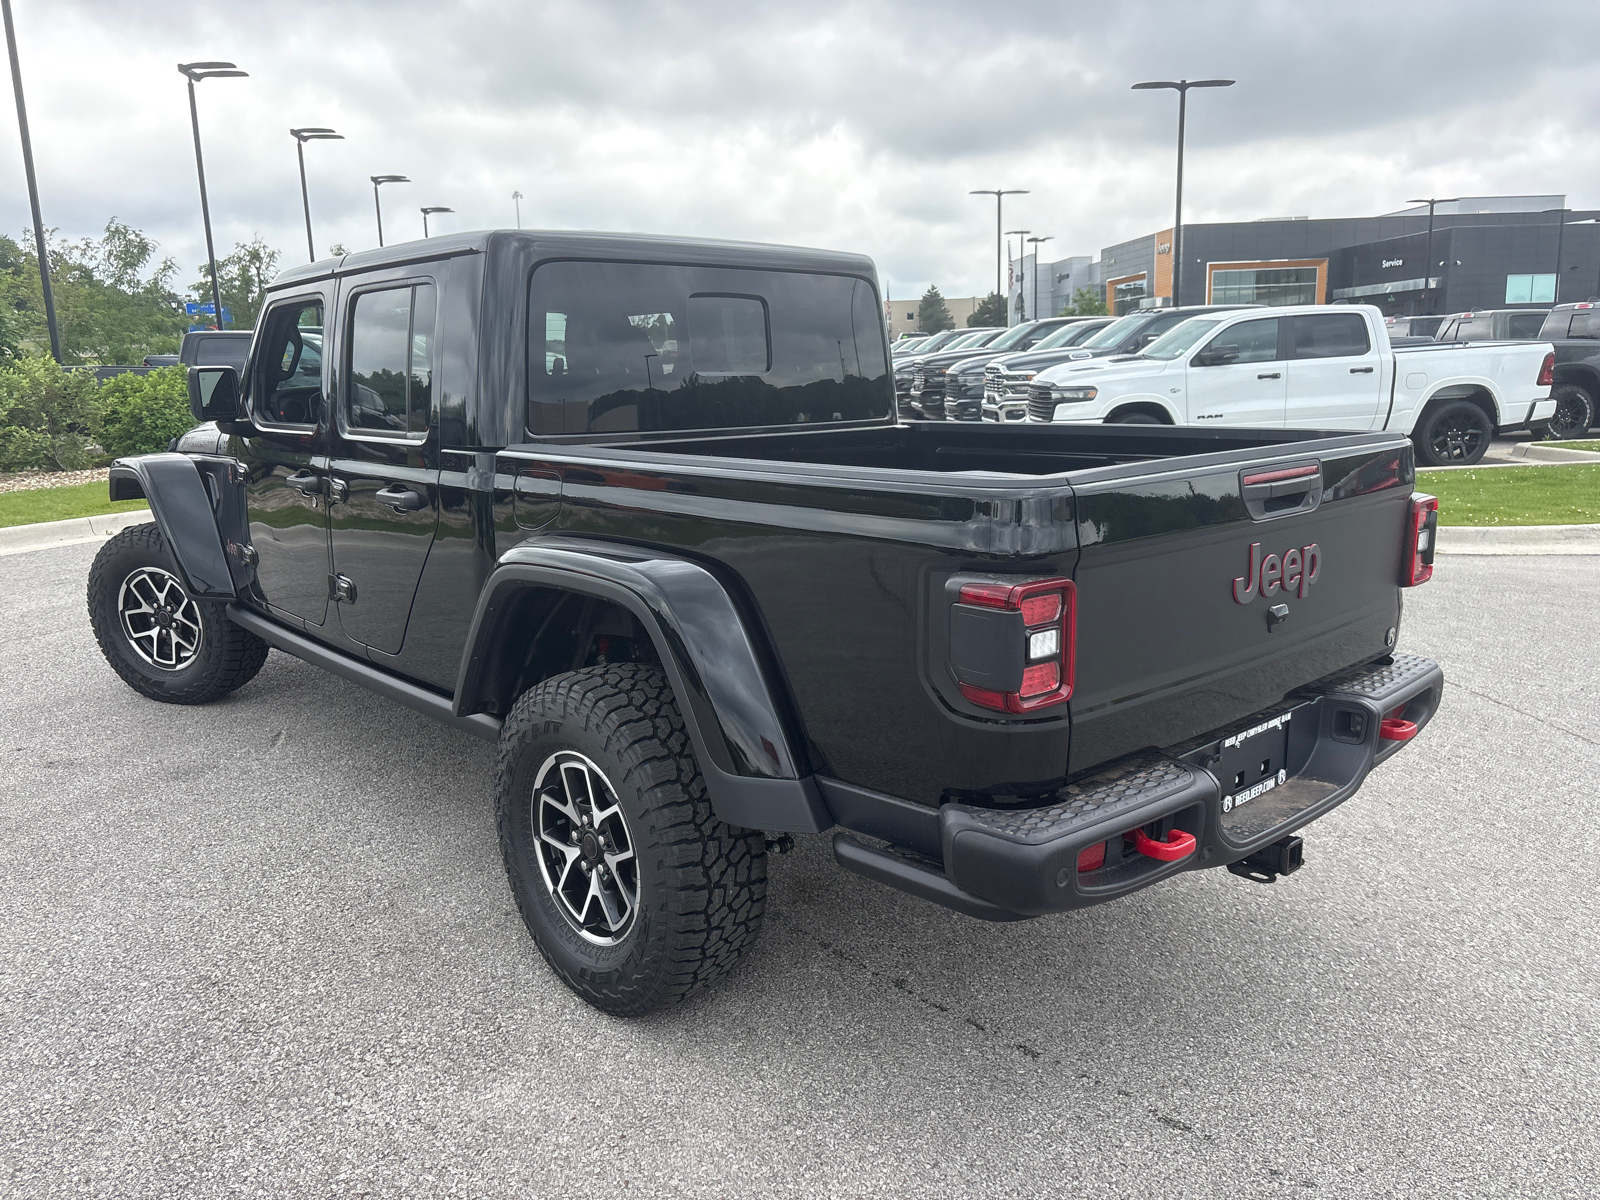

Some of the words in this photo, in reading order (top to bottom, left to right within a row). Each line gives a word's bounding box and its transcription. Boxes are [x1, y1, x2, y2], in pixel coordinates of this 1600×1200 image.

[1381, 258, 1403, 269] Service
[1232, 541, 1322, 606] Jeep
[1235, 777, 1276, 807] REEDJEEP.COM
